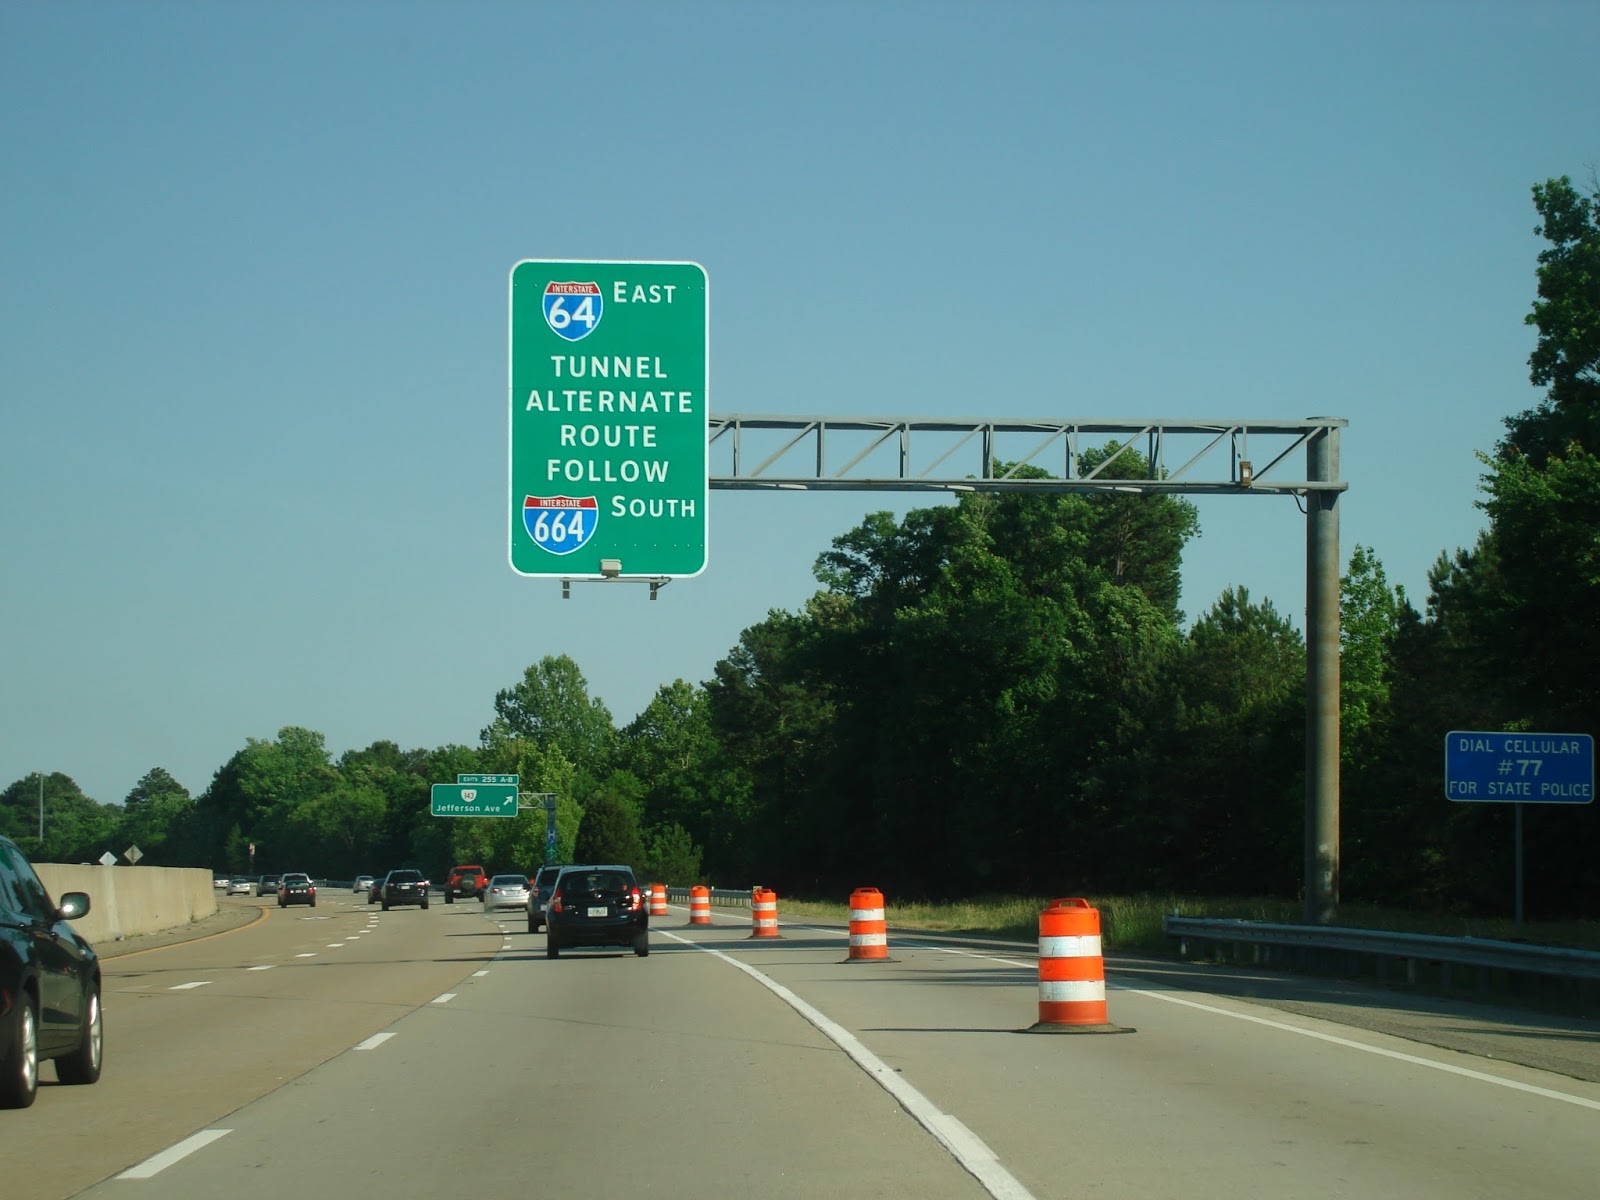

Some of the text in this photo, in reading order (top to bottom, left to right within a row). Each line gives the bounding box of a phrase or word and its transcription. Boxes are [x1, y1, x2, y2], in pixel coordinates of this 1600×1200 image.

[552, 284, 593, 294] INTERSTATE
[614, 281, 677, 304] EAST
[549, 296, 595, 329] 64
[551, 355, 668, 379] TUNNEL
[525, 389, 693, 413] ALTERNATE
[560, 424, 657, 448] ROUTE
[547, 459, 669, 483] FOLLOW
[540, 499, 581, 508] INTERSTATE
[611, 495, 695, 518] SOUTH
[534, 510, 584, 543] 664
[1459, 738, 1580, 754] DIAL CELLULAR
[1449, 781, 1590, 797] FOR STATE POLICE
[436, 804, 501, 813] Jefferson Ave
